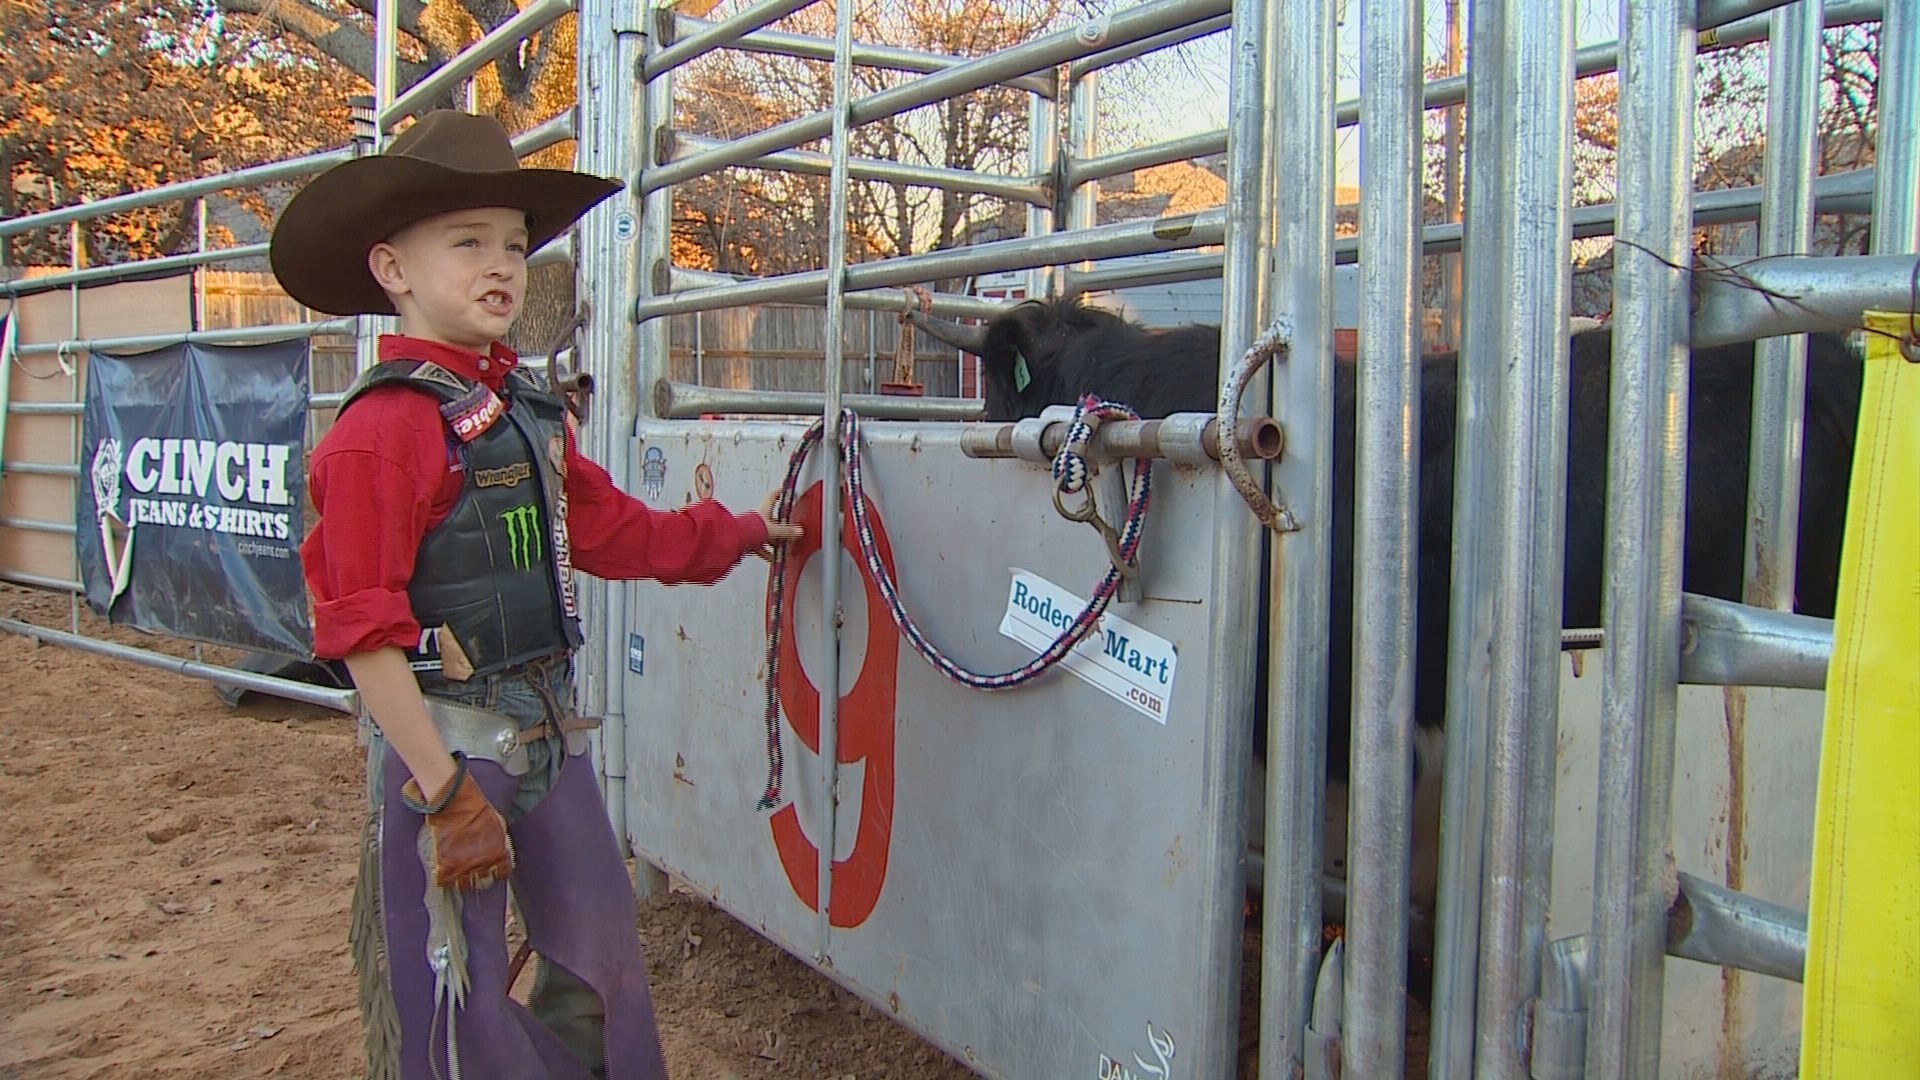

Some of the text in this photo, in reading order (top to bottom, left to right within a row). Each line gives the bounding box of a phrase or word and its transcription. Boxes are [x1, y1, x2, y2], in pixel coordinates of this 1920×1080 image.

[126, 437, 289, 505] CINCH
[475, 462, 530, 487] Wrangler
[127, 498, 187, 527] JEANS
[204, 505, 289, 540] SHIRTS
[238, 540, 290, 559] cinchjeans.com
[1103, 629, 1169, 685] Mart
[766, 479, 898, 929] 9
[1126, 687, 1162, 714] .com
